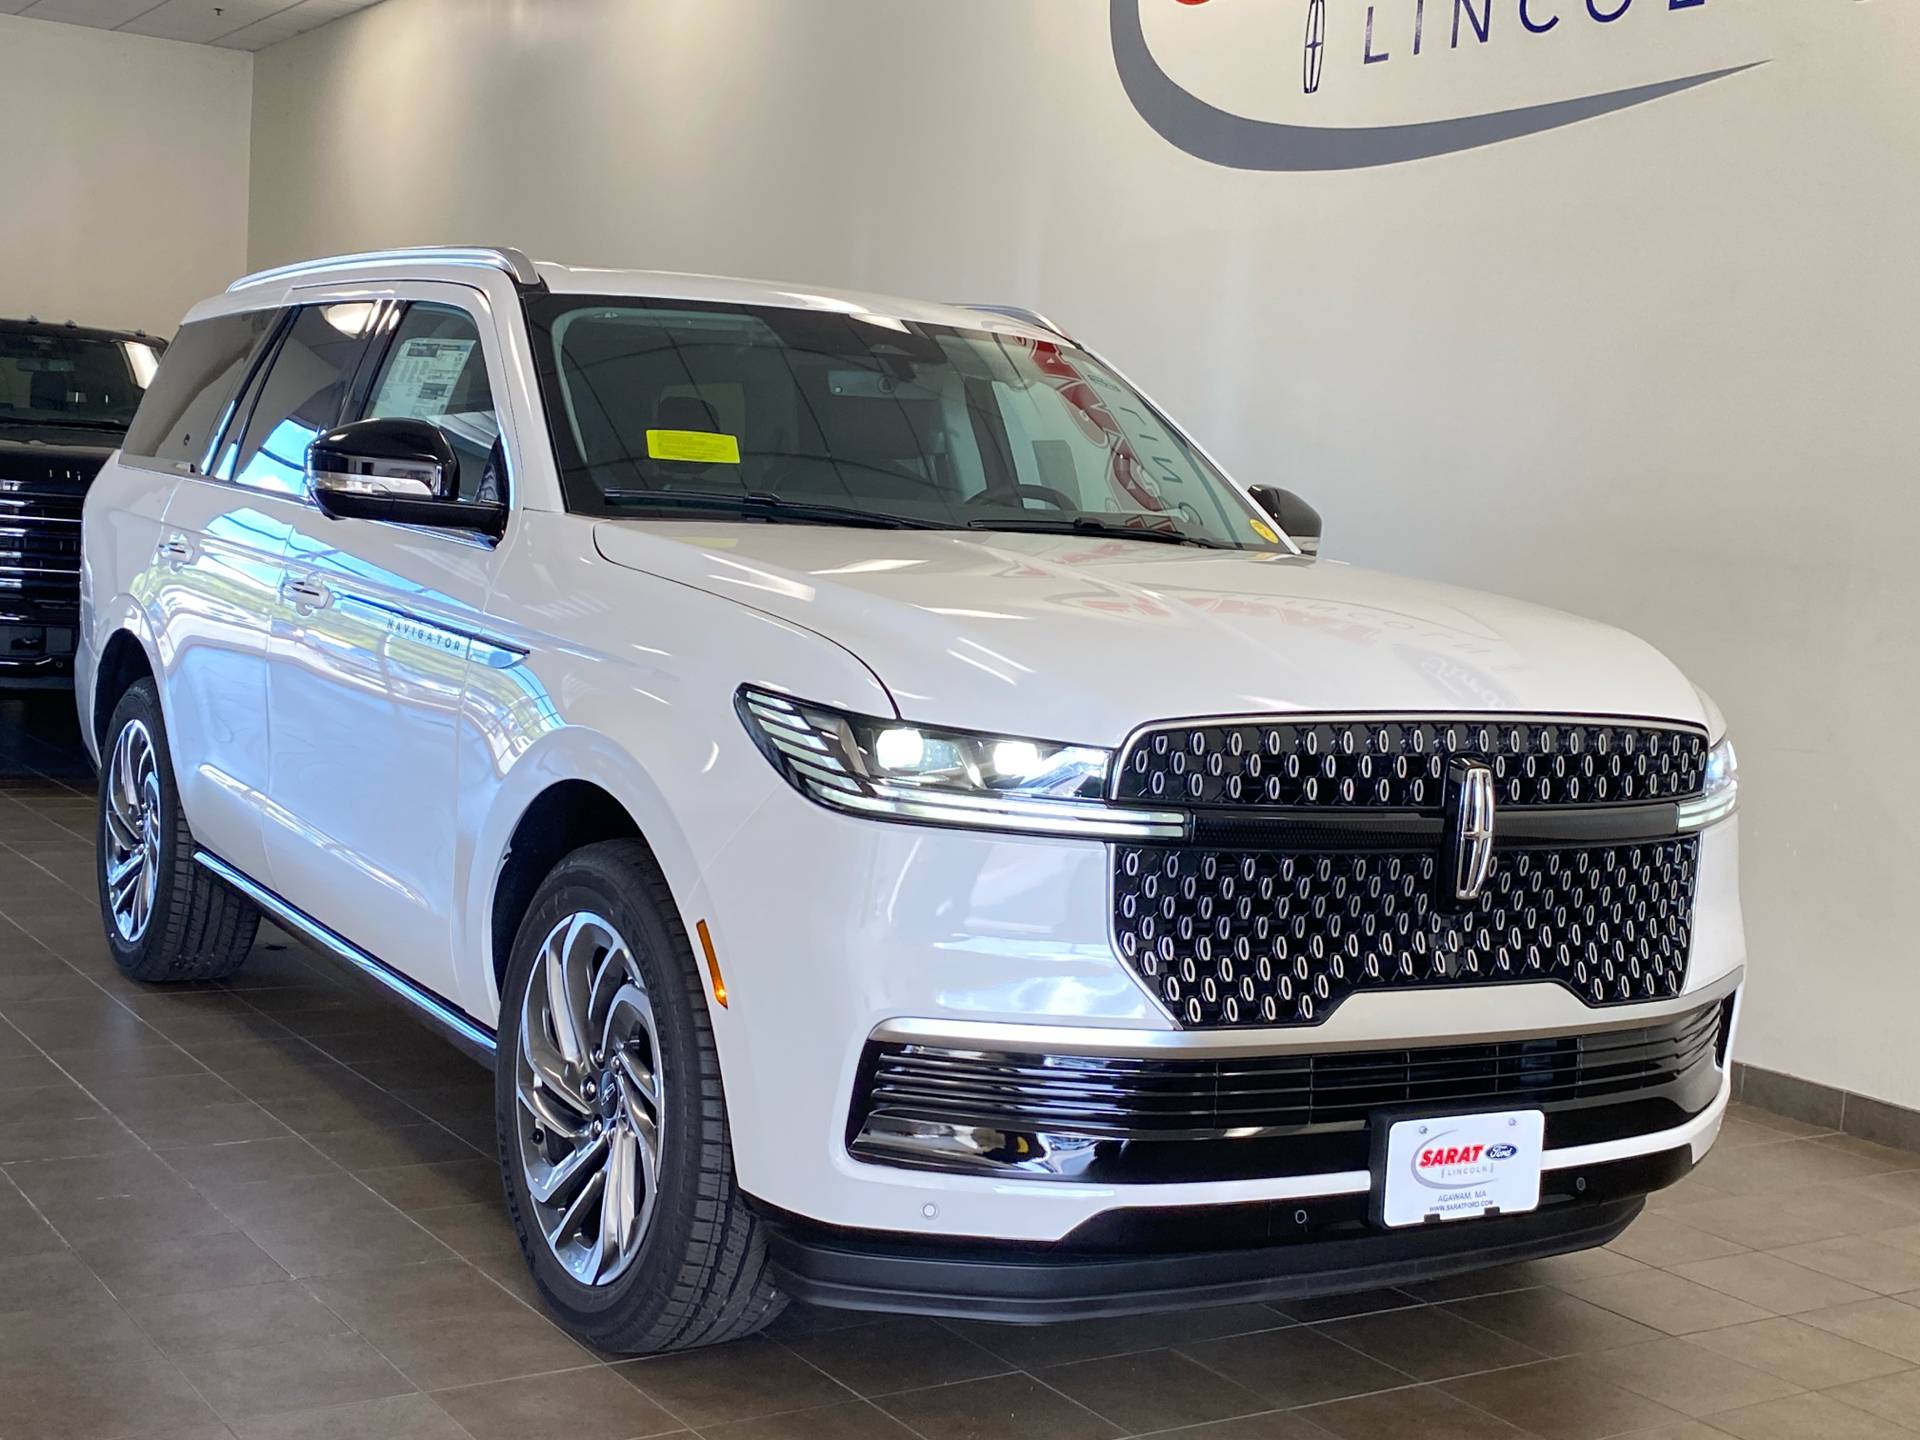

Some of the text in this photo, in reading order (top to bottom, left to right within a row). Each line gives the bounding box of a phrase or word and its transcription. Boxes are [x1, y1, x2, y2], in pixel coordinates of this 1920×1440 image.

[386, 618, 461, 651] NAVIGATOR
[1419, 1144, 1514, 1168] SARAT Ford
[1447, 1166, 1488, 1177] LINCOLN
[1437, 1190, 1487, 1202] AGAWAM, MA
[1429, 1200, 1494, 1212] WWW.SARATFORD.COM
